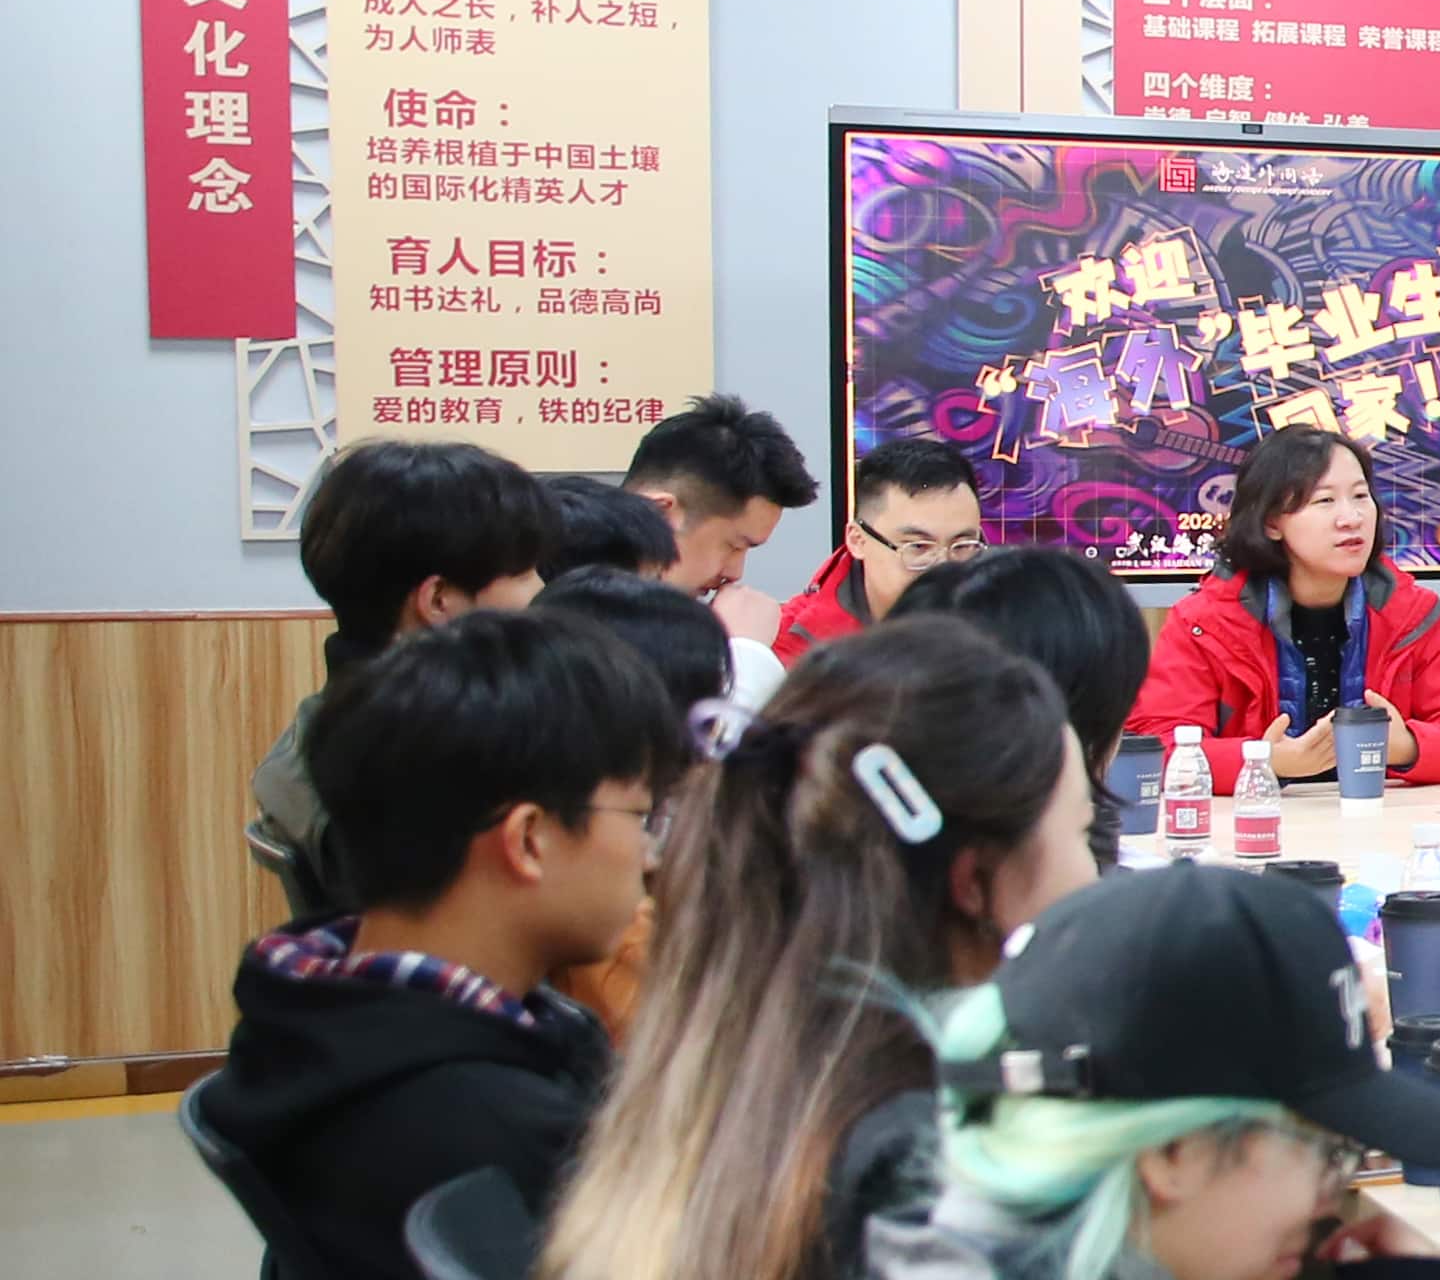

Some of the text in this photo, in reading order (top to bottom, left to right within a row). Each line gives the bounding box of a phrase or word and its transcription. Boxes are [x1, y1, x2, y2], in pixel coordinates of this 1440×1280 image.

[365, 24, 496, 57] 为人师表
[1143, 15, 1241, 42] 基础课程
[1251, 20, 1347, 47] 拓展课程
[1143, 72, 1273, 101] 四个维度：
[383, 88, 511, 130] 使命：
[366, 136, 661, 173] 培养根植于中国土壤
[367, 173, 629, 207] 的国际化精英人才
[387, 237, 609, 278] 育人目标：
[1053, 238, 1196, 327] 欢迎
[369, 284, 662, 316] 知书达礼，品德高尚
[389, 347, 610, 389] 管理原则：
[372, 397, 664, 426] 爱的教育，铁的纪律
